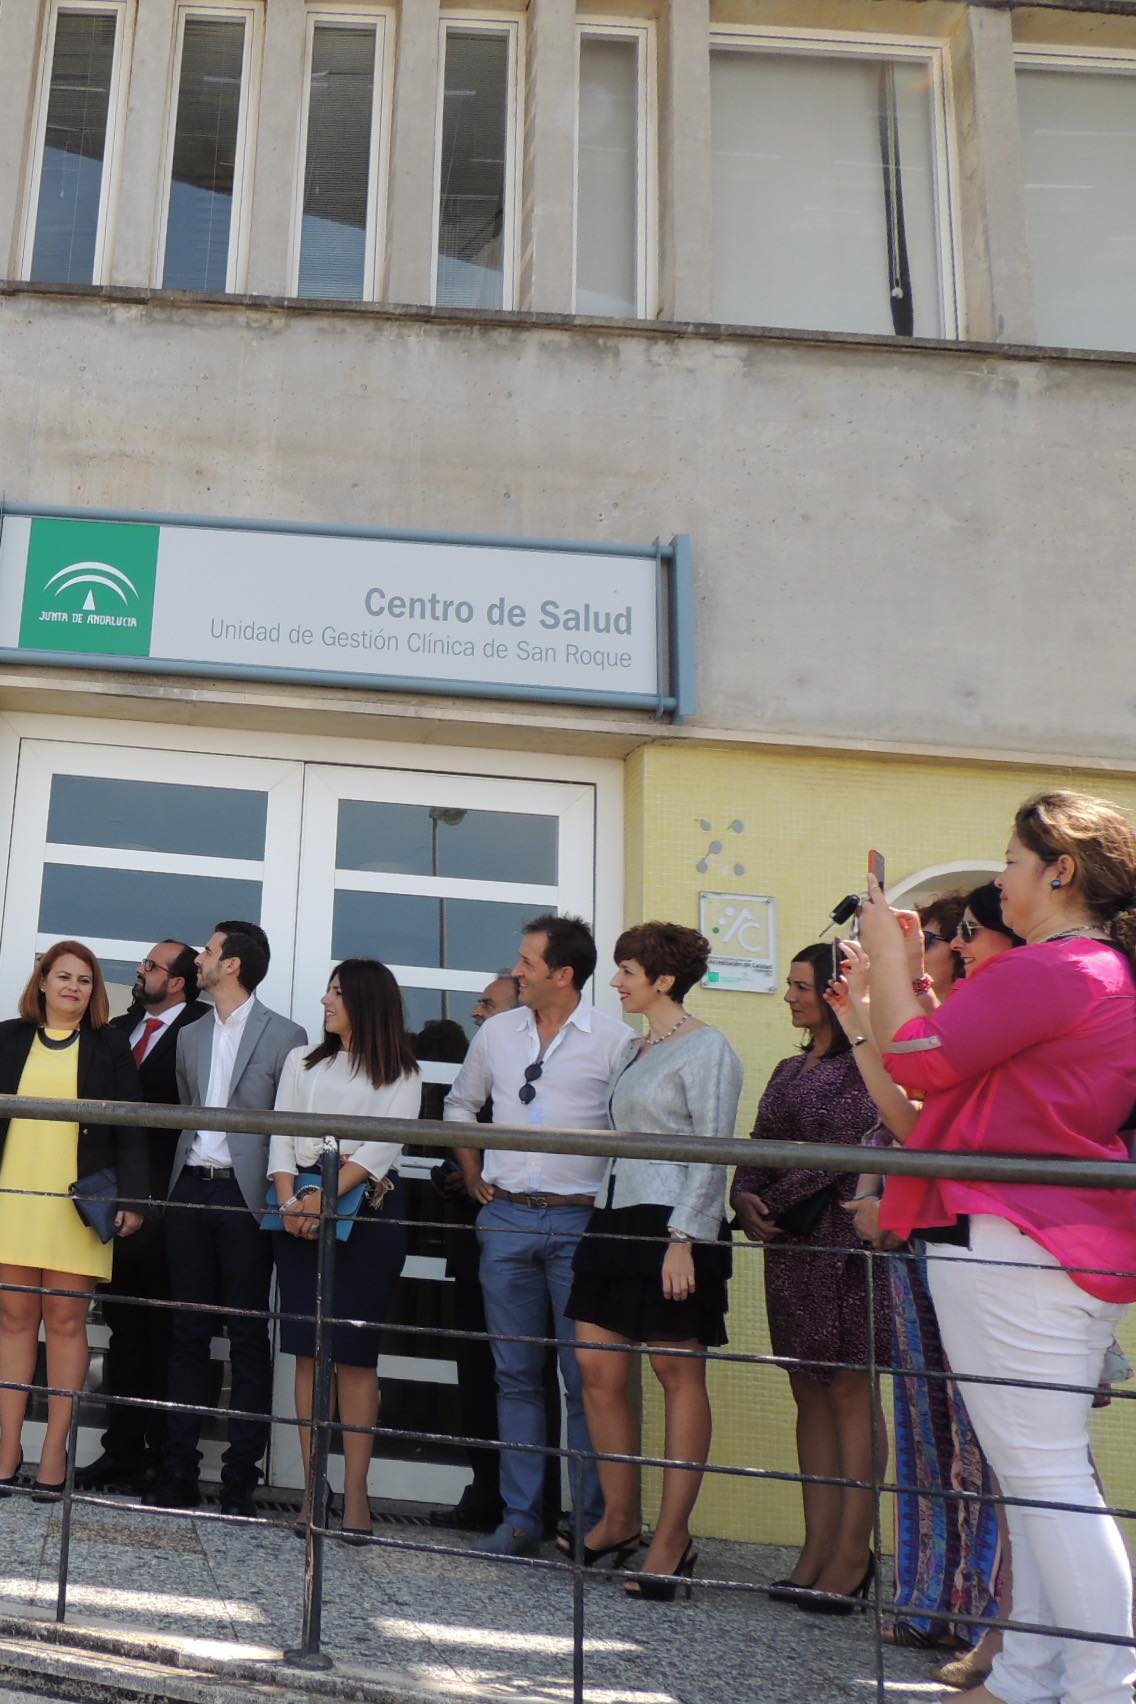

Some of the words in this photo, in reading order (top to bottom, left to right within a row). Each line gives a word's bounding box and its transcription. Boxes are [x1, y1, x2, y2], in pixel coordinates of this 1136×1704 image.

[38, 611, 68, 622] JUNTA
[72, 613, 83, 624] DE
[364, 587, 474, 624] Centro
[486, 597, 527, 627] de
[539, 600, 632, 635] Salud
[210, 618, 281, 643] Unidad
[288, 625, 313, 645] de
[321, 626, 399, 651] Gestión
[407, 632, 475, 656] Clínica
[483, 639, 508, 659] de
[516, 640, 556, 663] San
[566, 643, 632, 671] Roque
